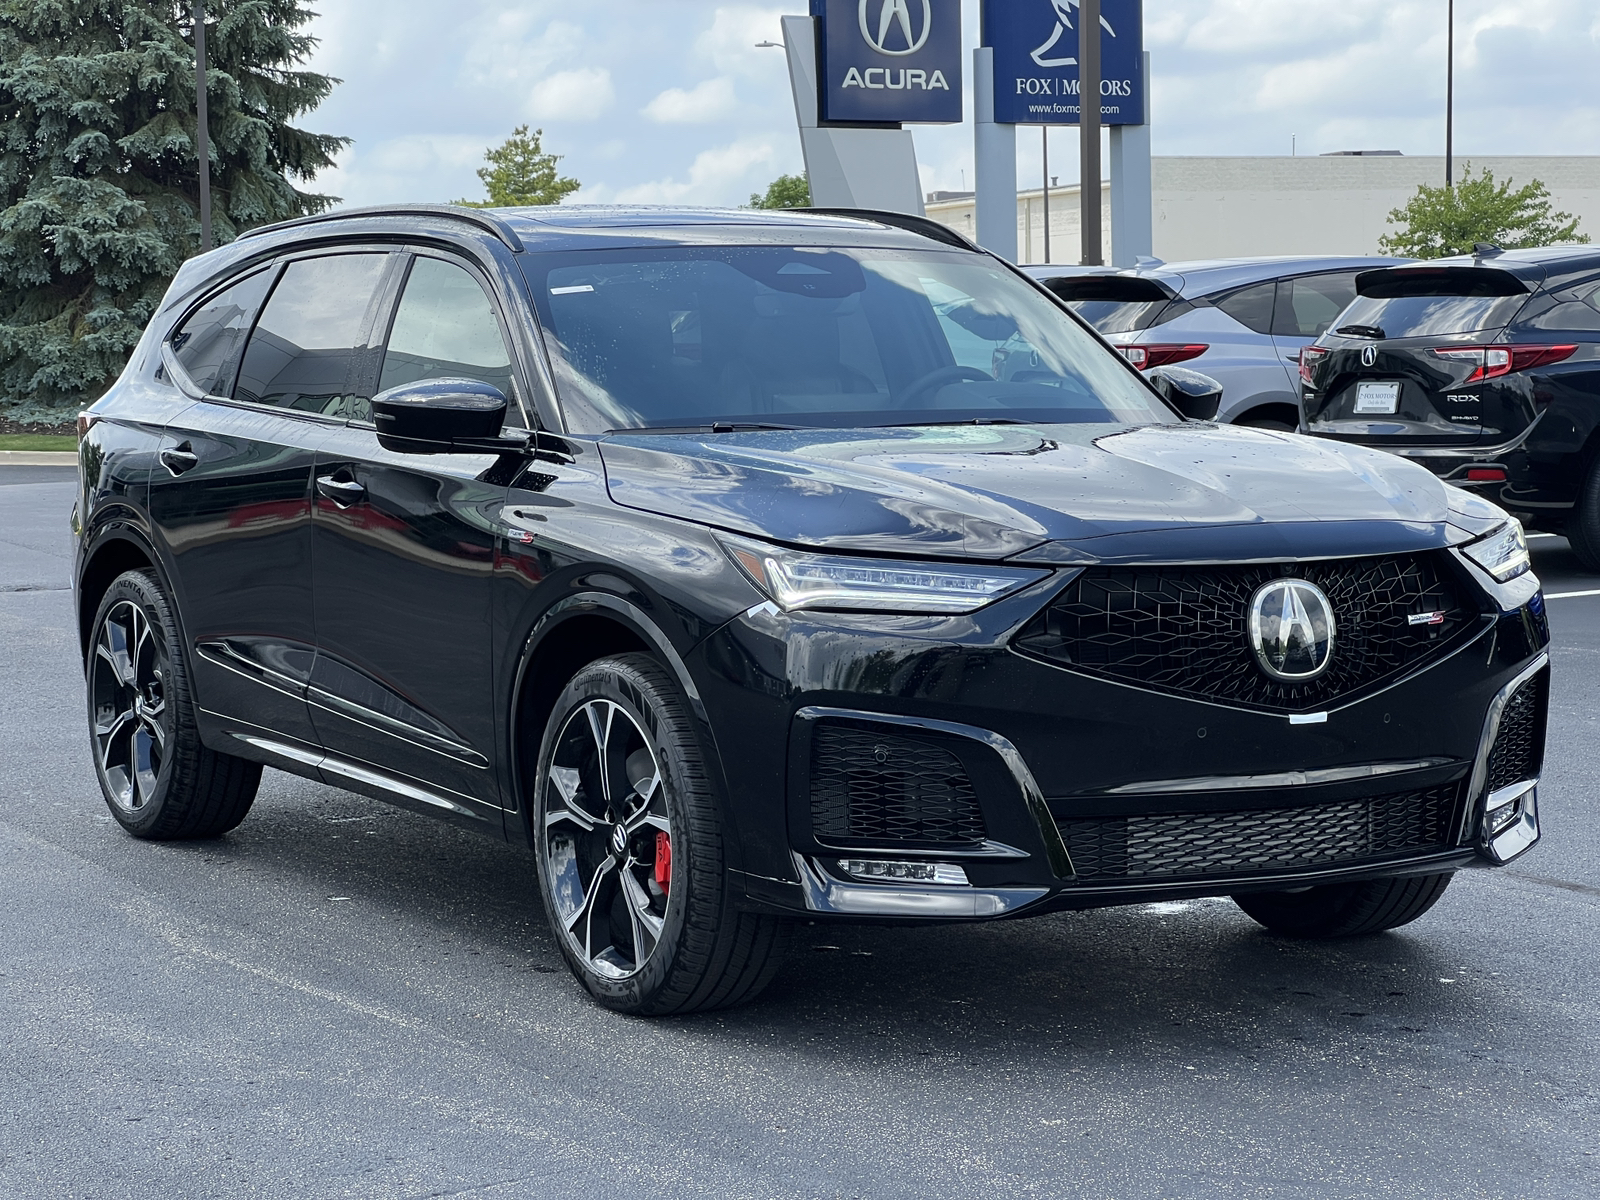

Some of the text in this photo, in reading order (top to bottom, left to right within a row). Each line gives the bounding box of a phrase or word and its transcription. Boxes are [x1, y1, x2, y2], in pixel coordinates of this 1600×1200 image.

[841, 66, 950, 90] ACURA
[1015, 78, 1131, 96] FOX MORS
[1446, 394, 1480, 403] RDX
